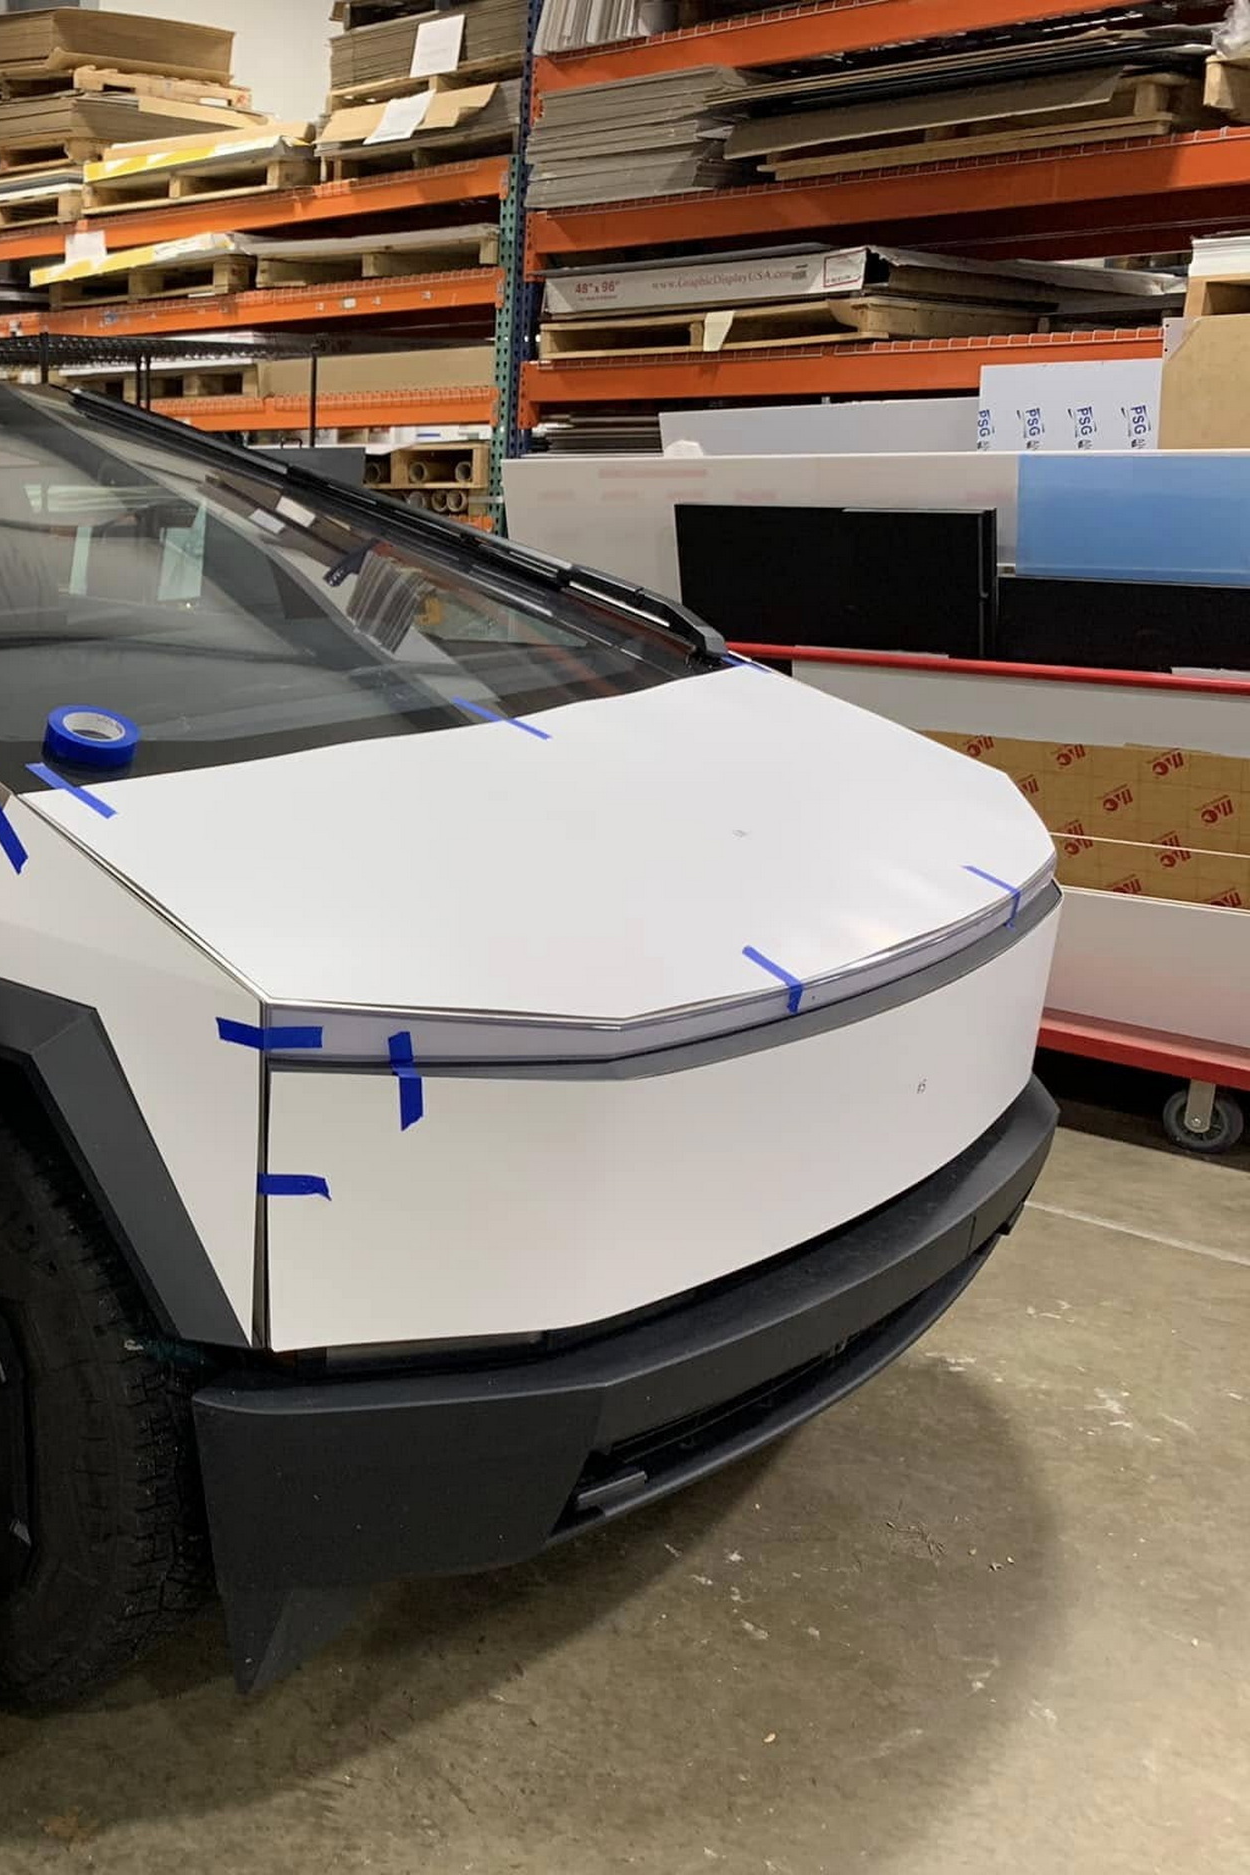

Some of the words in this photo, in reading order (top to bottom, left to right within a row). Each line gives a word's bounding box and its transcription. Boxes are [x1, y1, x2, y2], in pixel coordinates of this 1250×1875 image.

[1026, 408, 1041, 437] PSG
[1076, 406, 1093, 436] PSG
[1130, 405, 1147, 435] PSG
